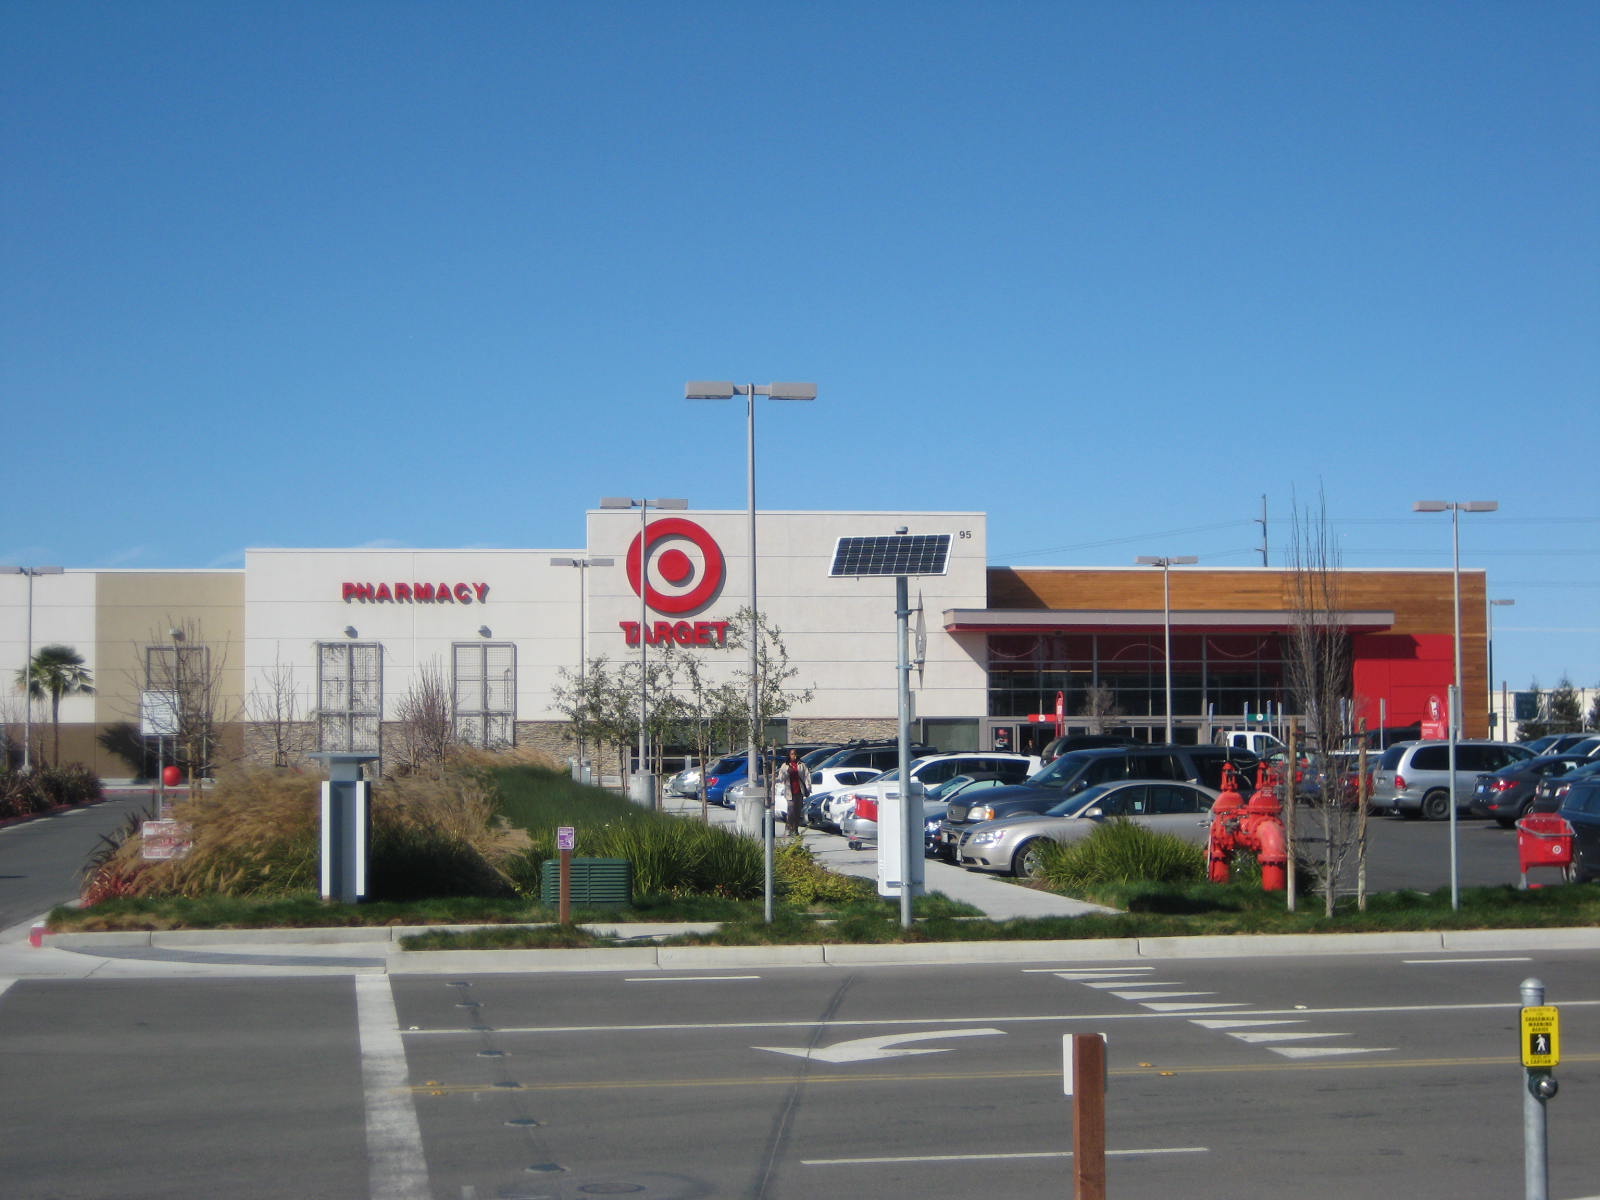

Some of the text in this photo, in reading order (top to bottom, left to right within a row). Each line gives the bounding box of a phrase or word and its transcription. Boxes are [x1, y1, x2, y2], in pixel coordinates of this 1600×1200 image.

[959, 530, 972, 539] 95
[342, 582, 489, 604] PHARMACY
[619, 621, 731, 647] TARGET
